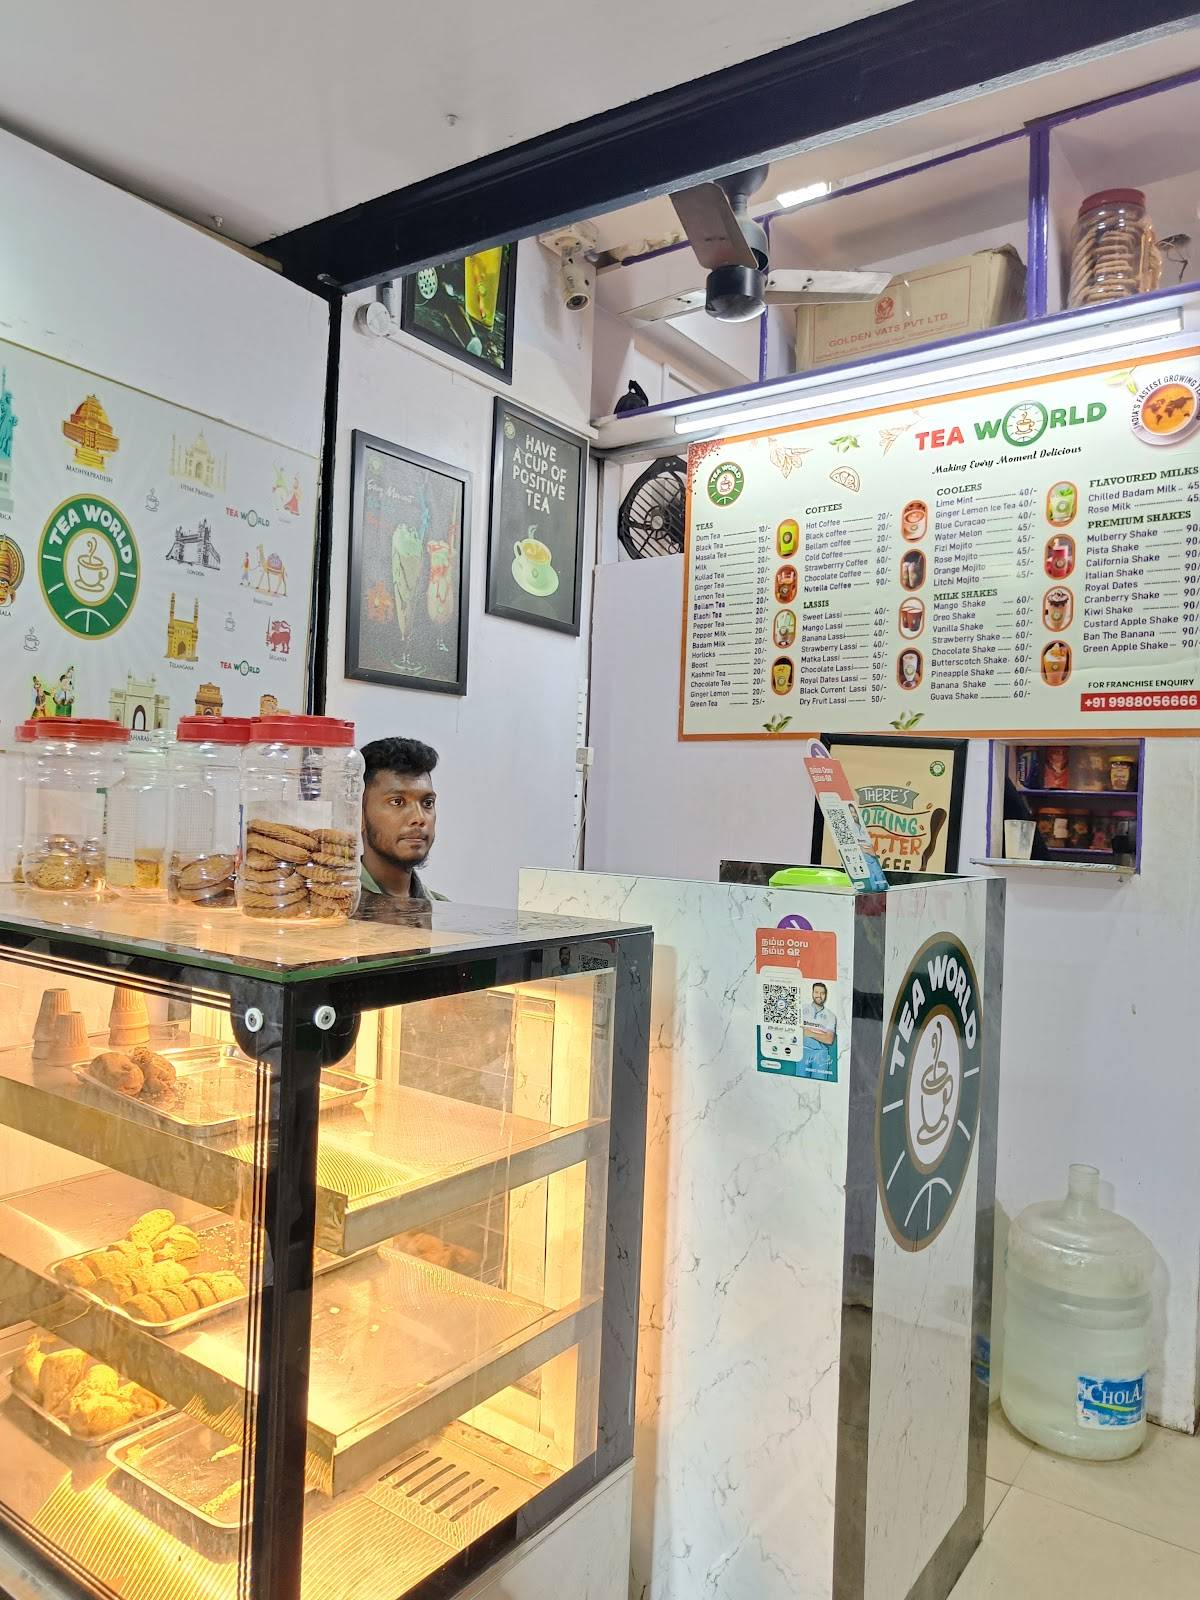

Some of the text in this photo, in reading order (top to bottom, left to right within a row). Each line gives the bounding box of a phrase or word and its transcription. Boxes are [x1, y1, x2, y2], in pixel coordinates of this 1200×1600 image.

[829, 332, 871, 347] GOLDEN
[875, 324, 901, 336] VATS
[903, 319, 924, 329] PVT
[928, 313, 948, 324] LTD
[1137, 379, 1161, 403] FASTEST
[1164, 374, 1197, 386] GROWING
[915, 400, 1107, 450] TEA WORLD
[526, 435, 557, 462] HAVE
[513, 448, 567, 483] A CUP OF
[932, 446, 1082, 474] Making Every Moment Delicious
[513, 465, 565, 500] POSITIVE
[1090, 466, 1199, 488] FLAVOURED MILKS
[937, 484, 982, 496] COOLERS
[1089, 484, 1176, 502] Chilled Badam Milk
[526, 489, 550, 514] TEA
[936, 500, 954, 508] Lime
[806, 503, 842, 514] COFFEES
[936, 511, 959, 519] Ginger
[962, 505, 988, 515] Lemon
[1088, 503, 1131, 514] Rose Milk
[226, 507, 238, 518] TEA
[241, 510, 269, 527] WORLD
[1088, 511, 1191, 528] PREMIUM SHAKES
[696, 523, 713, 531] TEAS
[806, 520, 840, 530] Hot Coffee
[935, 519, 985, 530] Blue Curacao
[49, 504, 133, 564] TEA WORLD
[826, 530, 846, 538] coffee
[935, 529, 982, 541] Water Melon
[1087, 529, 1158, 542] Mulberry Shake
[830, 540, 851, 548] coffee
[949, 542, 972, 551] Mojito
[1087, 544, 1139, 555] Pista Shake
[821, 551, 843, 559] Coffee
[935, 553, 978, 564] Rose Mojito
[846, 559, 868, 567] Coffee
[1087, 555, 1160, 567] California Shake
[934, 564, 985, 575] Orange Mojito
[1086, 568, 1144, 580] Italian Shake
[805, 570, 861, 582] Chocolate Coffee
[934, 576, 979, 587] Litchi Mojito
[804, 582, 851, 593] Nutella Coffee
[1085, 581, 1138, 592] Royal Dates
[934, 589, 998, 601] MILK SHAKES
[1085, 591, 1160, 604] Cranberry Shake
[803, 600, 829, 609] LASSIS
[934, 600, 985, 611] Mango Shake
[803, 611, 842, 621] Sweet Lassi
[952, 612, 975, 620] Shake
[1084, 606, 1133, 616] Kiwi Shake
[1084, 615, 1178, 628] Custard Apple Shake
[933, 623, 983, 632] Vanilla Shake
[933, 633, 1000, 644] Strawberry Shake
[1084, 633, 1100, 641] Ban
[1121, 630, 1155, 638] Banana
[801, 645, 838, 653] Strawberry
[932, 645, 995, 656] Chocolate Shake
[1083, 641, 1168, 653] Green Apple Shake
[932, 658, 980, 666] Butterscotch
[220, 660, 260, 676] TEA WORLD
[931, 670, 968, 678] Pineapple
[931, 680, 986, 689] Banana Shake
[1106, 680, 1153, 688] FRANCHISE
[956, 691, 978, 699] Shake
[800, 698, 810, 706] Dry
[1085, 695, 1198, 707] +91 9988056666
[863, 788, 910, 803] THERE'S
[860, 808, 917, 835] OTHING
[869, 832, 922, 856] TTER
[762, 937, 808, 947] நம்ம Ooru
[762, 946, 784, 955] நம்ம
[890, 955, 977, 1075] TEA WORLD
[1090, 1384, 1142, 1404] CHOLA
